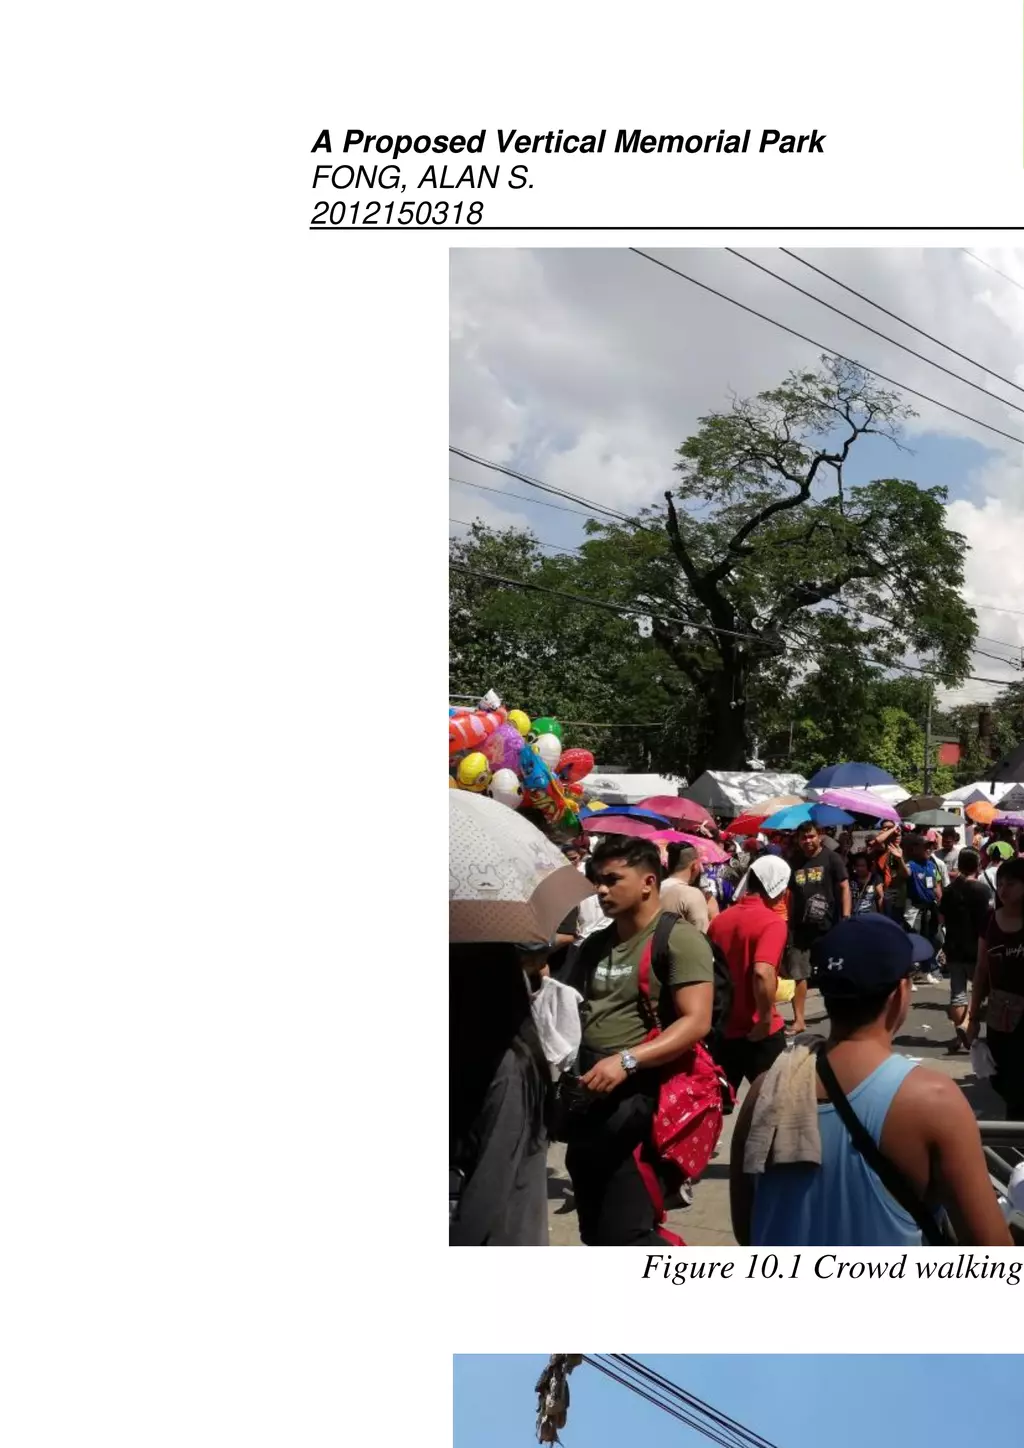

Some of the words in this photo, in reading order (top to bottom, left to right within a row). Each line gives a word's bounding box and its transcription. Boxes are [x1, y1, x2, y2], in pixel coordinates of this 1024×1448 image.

[310, 129, 332, 153] A
[342, 129, 487, 160] Proposed
[497, 129, 607, 154] Vertical
[614, 129, 752, 154] Memorial
[758, 129, 827, 154] Park
[312, 164, 407, 194] FONG,
[416, 164, 501, 189] ALAN
[507, 164, 534, 190] S.
[310, 200, 484, 226] 2012150318
[641, 1254, 735, 1286] Figure
[745, 1253, 802, 1279] 10.1
[814, 1253, 908, 1279] Crowd
[915, 1253, 1024, 1286] walking
